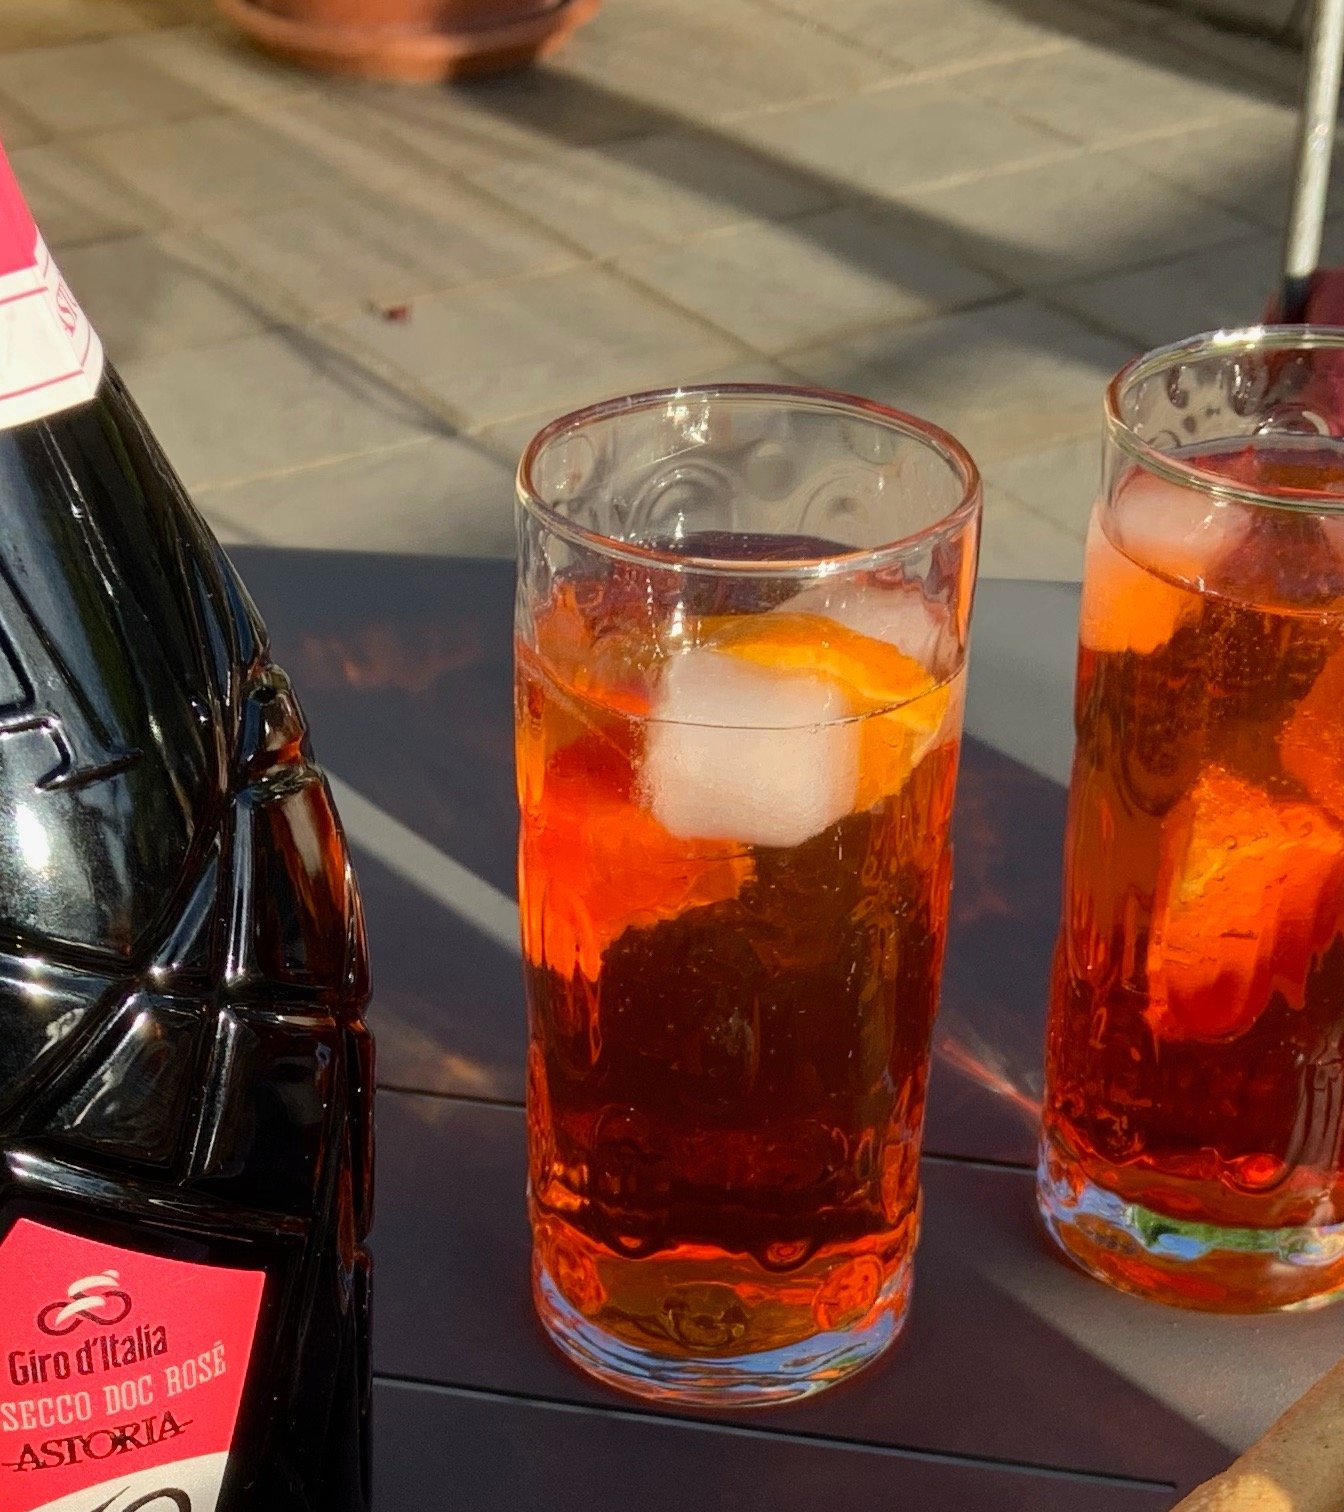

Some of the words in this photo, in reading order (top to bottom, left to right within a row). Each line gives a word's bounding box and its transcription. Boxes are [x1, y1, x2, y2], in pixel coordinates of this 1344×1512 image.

[8, 1349, 71, 1386] Giro
[76, 1323, 169, 1376] d'Italia
[102, 1374, 154, 1416] DOC
[2, 1410, 194, 1473] ASTORIA
